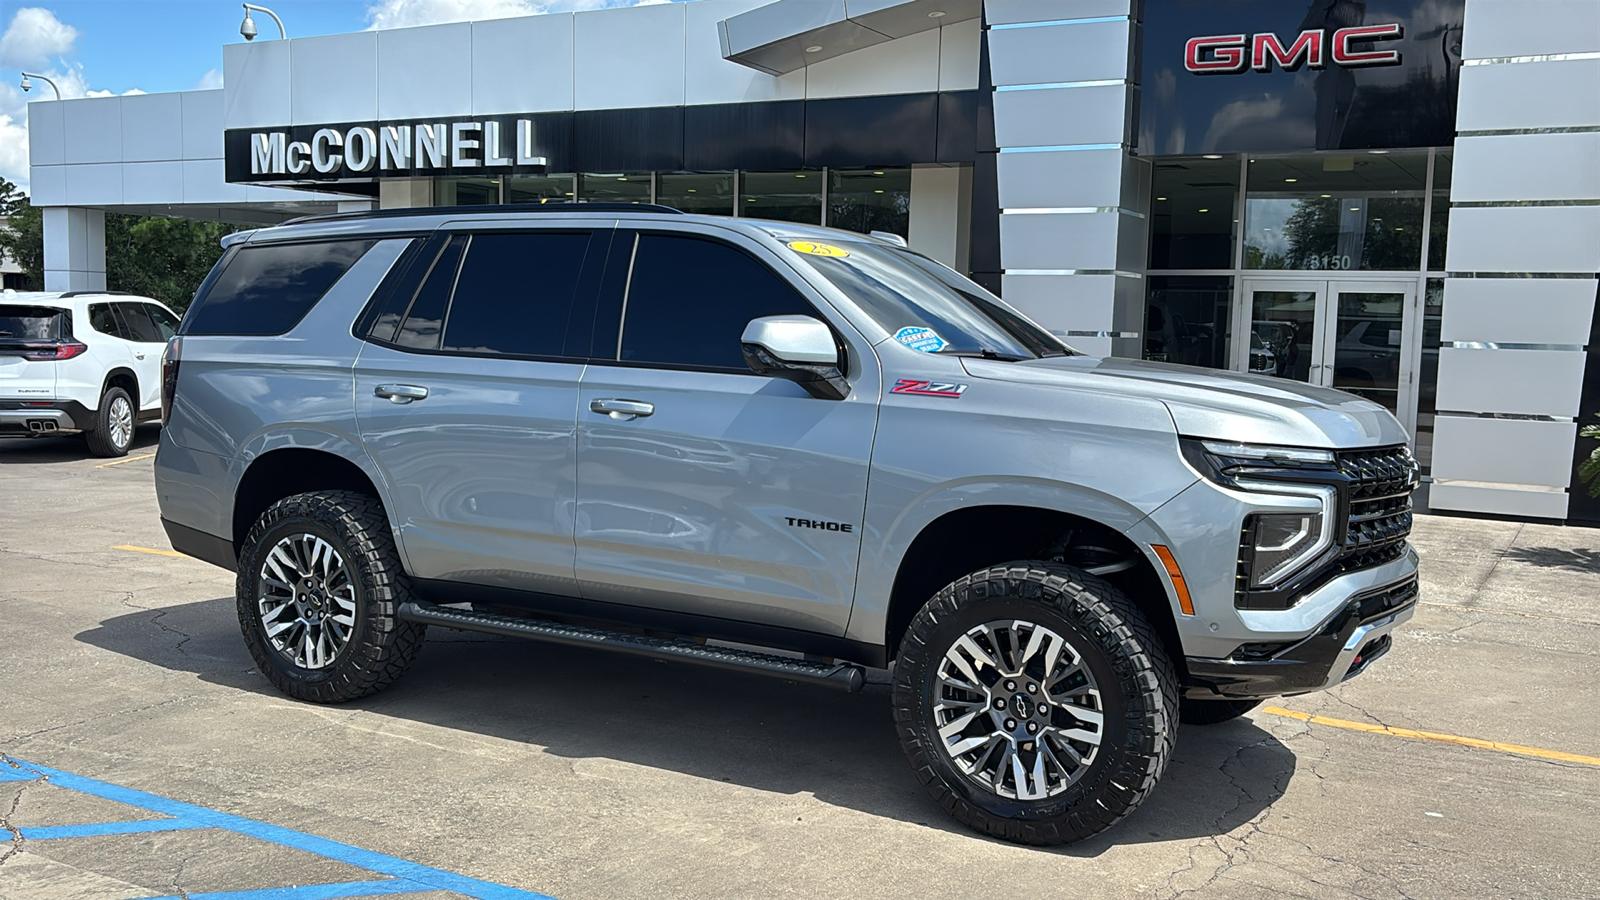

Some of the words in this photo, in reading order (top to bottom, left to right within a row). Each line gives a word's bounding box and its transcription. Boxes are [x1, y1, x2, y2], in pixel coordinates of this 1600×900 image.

[1183, 22, 1404, 76] GMC
[251, 119, 547, 175] McCONNELL
[806, 243, 832, 255] 25
[1310, 255, 1351, 270] 3150
[889, 378, 969, 399] Z71
[785, 517, 853, 533] TAHOE
